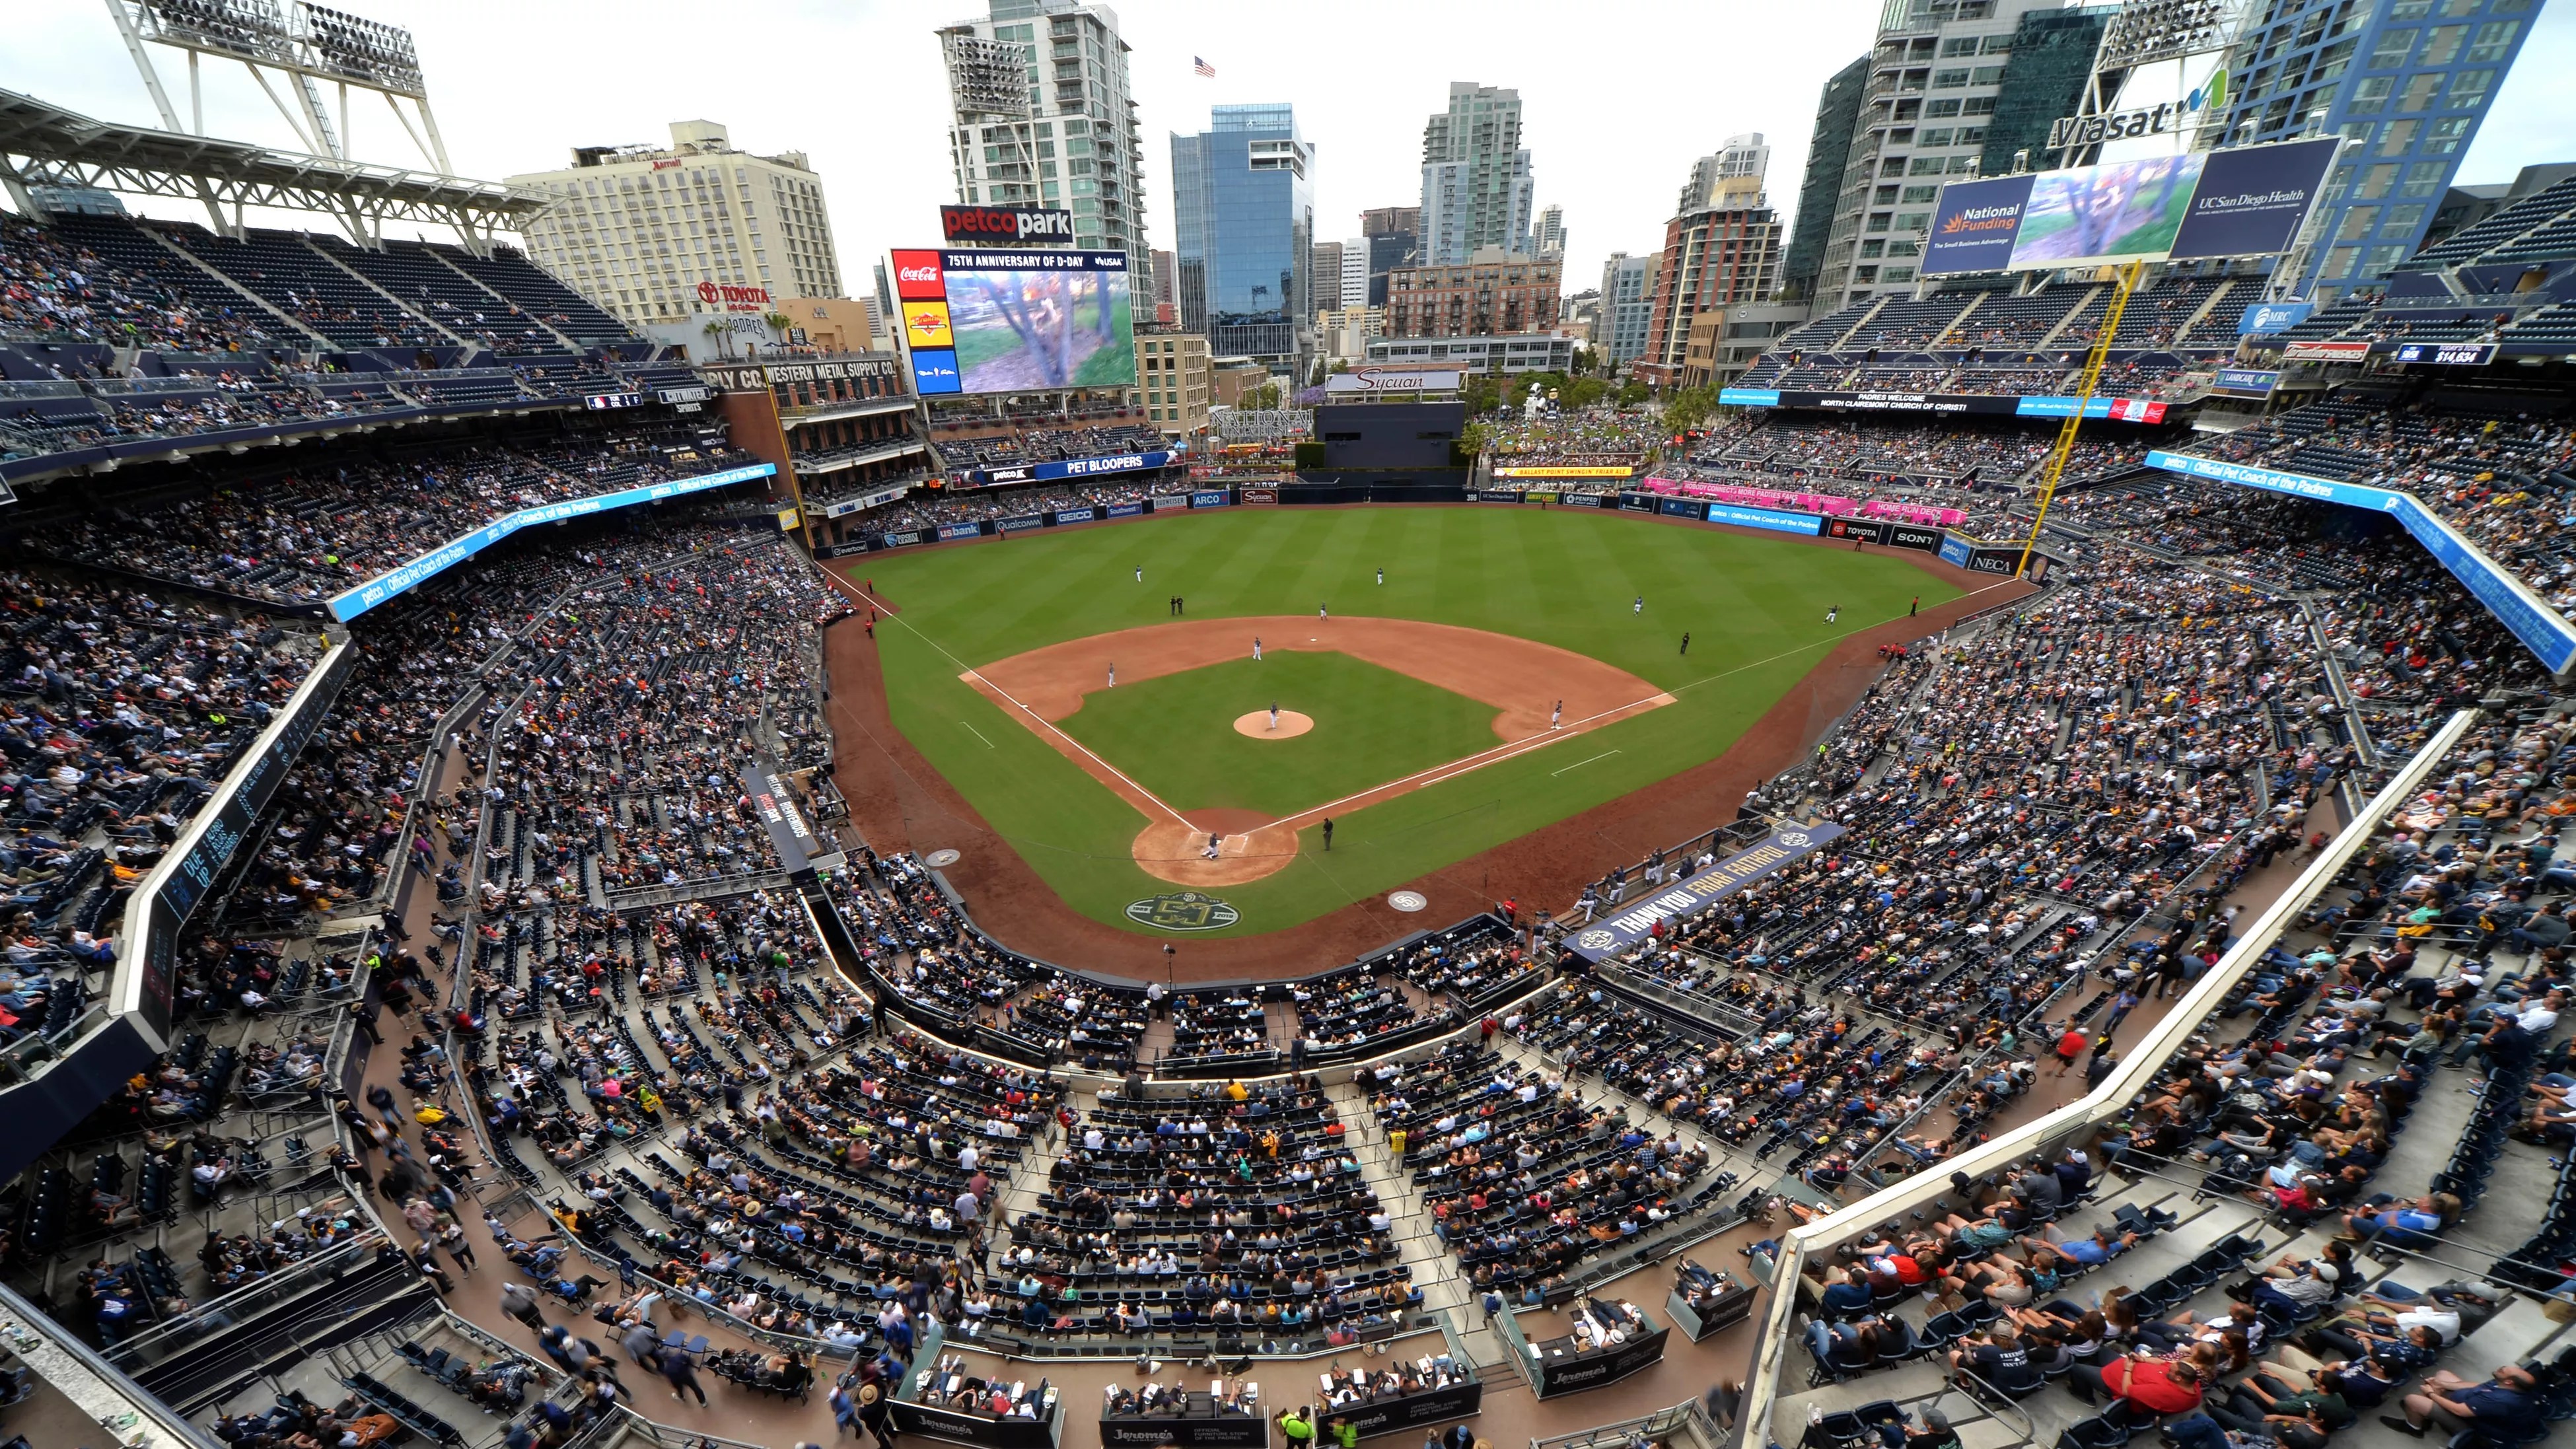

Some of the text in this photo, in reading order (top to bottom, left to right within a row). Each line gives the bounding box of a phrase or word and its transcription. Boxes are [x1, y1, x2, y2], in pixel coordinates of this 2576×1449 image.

[2057, 103, 2166, 146] Viasat
[2200, 190, 2304, 209] UC San Diego Health
[1963, 203, 2021, 220] National
[1961, 218, 2015, 231] Funding
[948, 255, 1083, 267] 75TH ANNIVERSARY OF D-DAY
[720, 285, 770, 303] TOYOTA
[2268, 311, 2291, 322] MRC
[727, 318, 766, 339] PADRES
[2435, 351, 2477, 363] $14,634
[740, 370, 768, 388] CO.
[765, 361, 896, 383] WESTERN METAL SUPPLY CO.
[1356, 367, 1424, 395] Sycuan
[676, 402, 701, 413] SPIRITS
[1219, 425, 1308, 438] UNIVERSITY
[1067, 456, 1143, 474] PET BLOOPERS
[993, 470, 1016, 481] petco
[2163, 456, 2333, 497] petco Official Pet Coach of the Padres
[677, 479, 700, 491] Official
[700, 477, 711, 488] Pet
[711, 475, 729, 486] Coach
[1245, 491, 1271, 503] Sycuan
[1738, 487, 1755, 496] MORE
[1156, 497, 1184, 506] BUDWEISER
[1195, 495, 1219, 505] ARCO
[517, 501, 600, 524] Coach of the Padres
[1058, 511, 1092, 522] GEICO
[1110, 506, 1136, 514] Southwest
[1877, 503, 1943, 517] HOME RUN DECK
[997, 518, 1041, 529] Qualcomm
[1762, 516, 1779, 524] Coach
[1797, 520, 1818, 529] Padres
[1847, 527, 1876, 537] TOYOTA
[1898, 533, 1933, 544] SONY
[1942, 543, 1958, 557] petco
[1974, 557, 2010, 571] NECA
[361, 545, 466, 607] petco Official Pet Coach of the Padres
[765, 773, 787, 798] WELCOME
[182, 849, 205, 877] DUE
[196, 868, 211, 888] UP
[1610, 845, 1791, 935] THANK YOU FRIAR FAITHFUL
[1553, 1364, 1606, 1384] Jerome's
[918, 1415, 972, 1434] Jerome's
[1114, 1429, 1174, 1440] Jerome's
